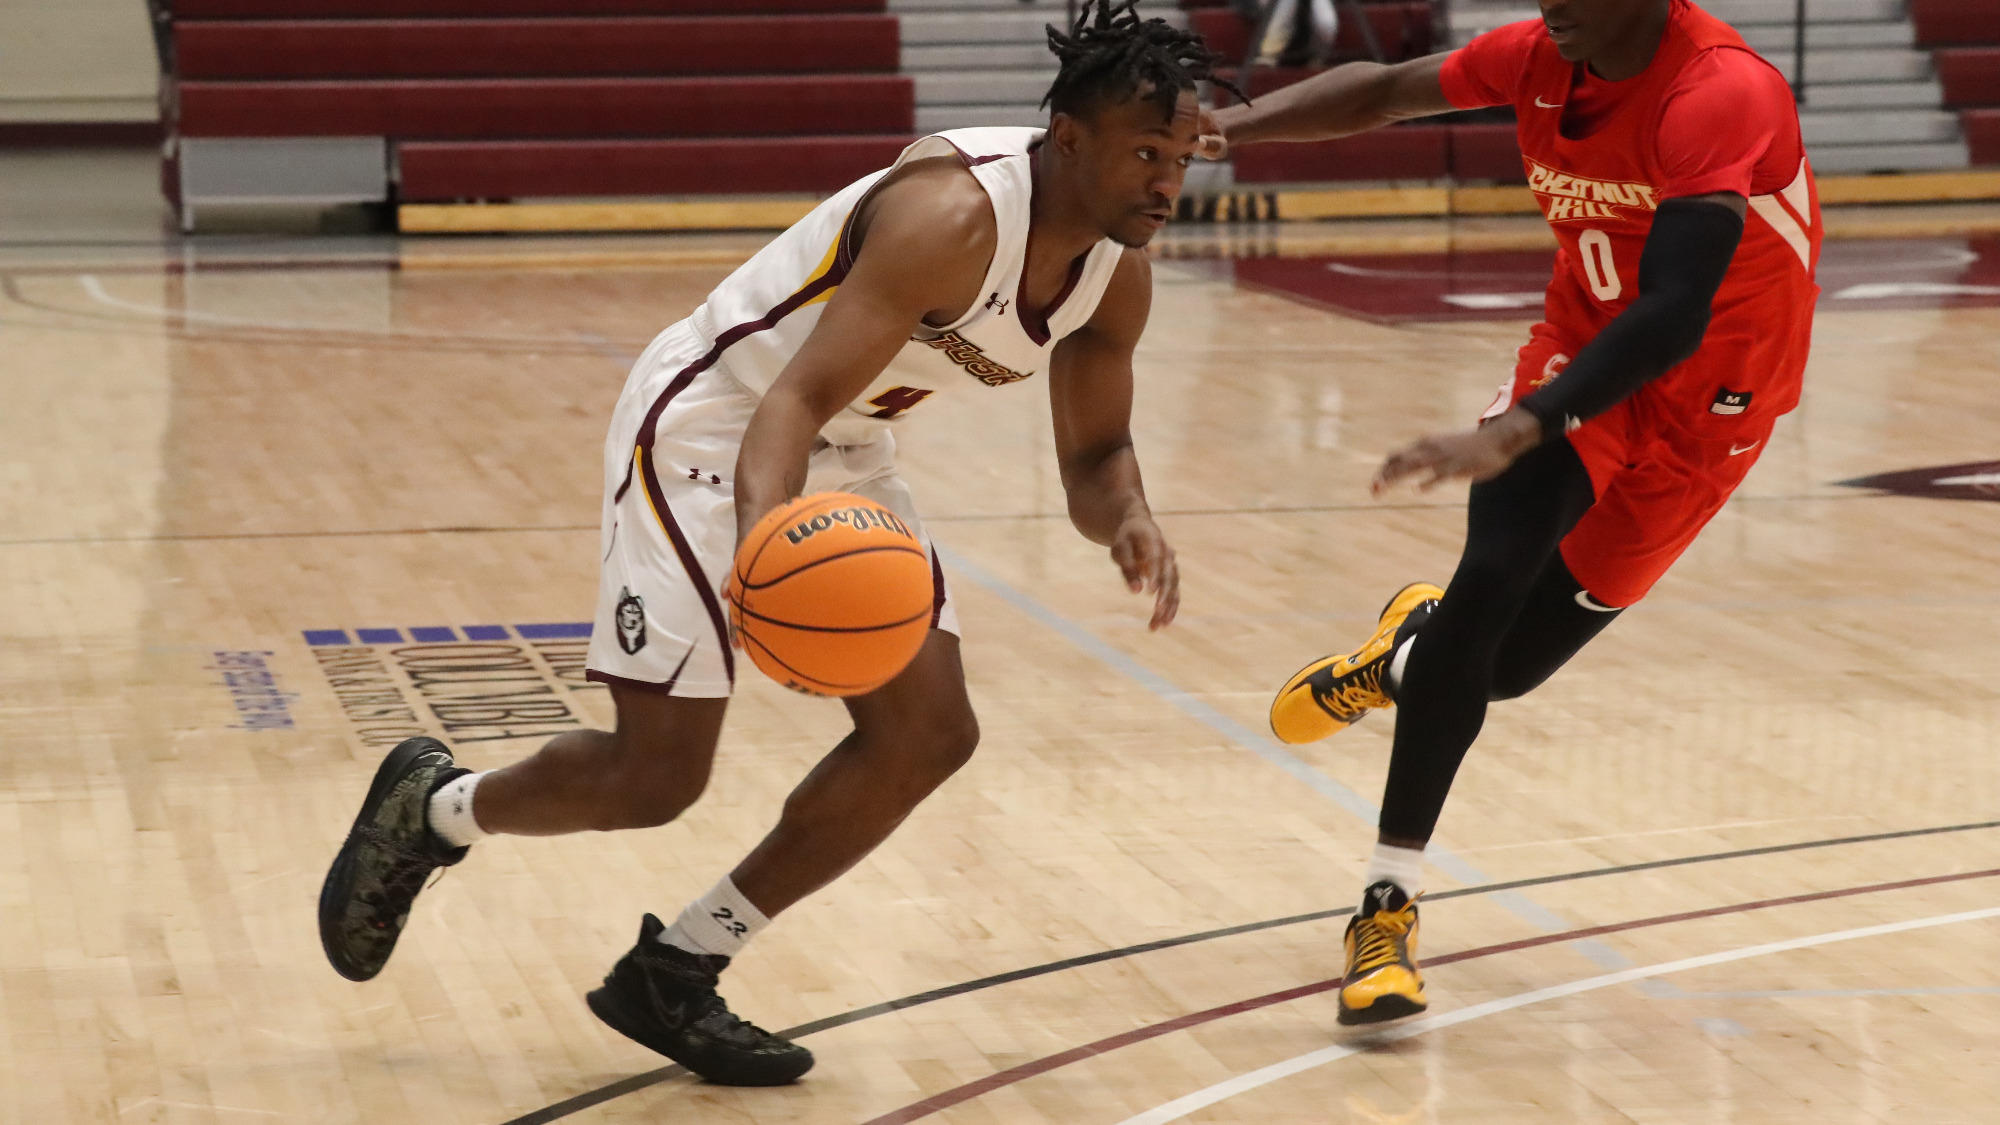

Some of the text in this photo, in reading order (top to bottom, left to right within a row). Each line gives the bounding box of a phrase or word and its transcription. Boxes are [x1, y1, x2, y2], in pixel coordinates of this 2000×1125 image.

[1529, 162, 1658, 211] CHESTNUT
[1547, 195, 1620, 221] HILL
[1578, 228, 1623, 302] 0
[1725, 395, 1741, 405] M
[785, 506, 914, 545] Wilson
